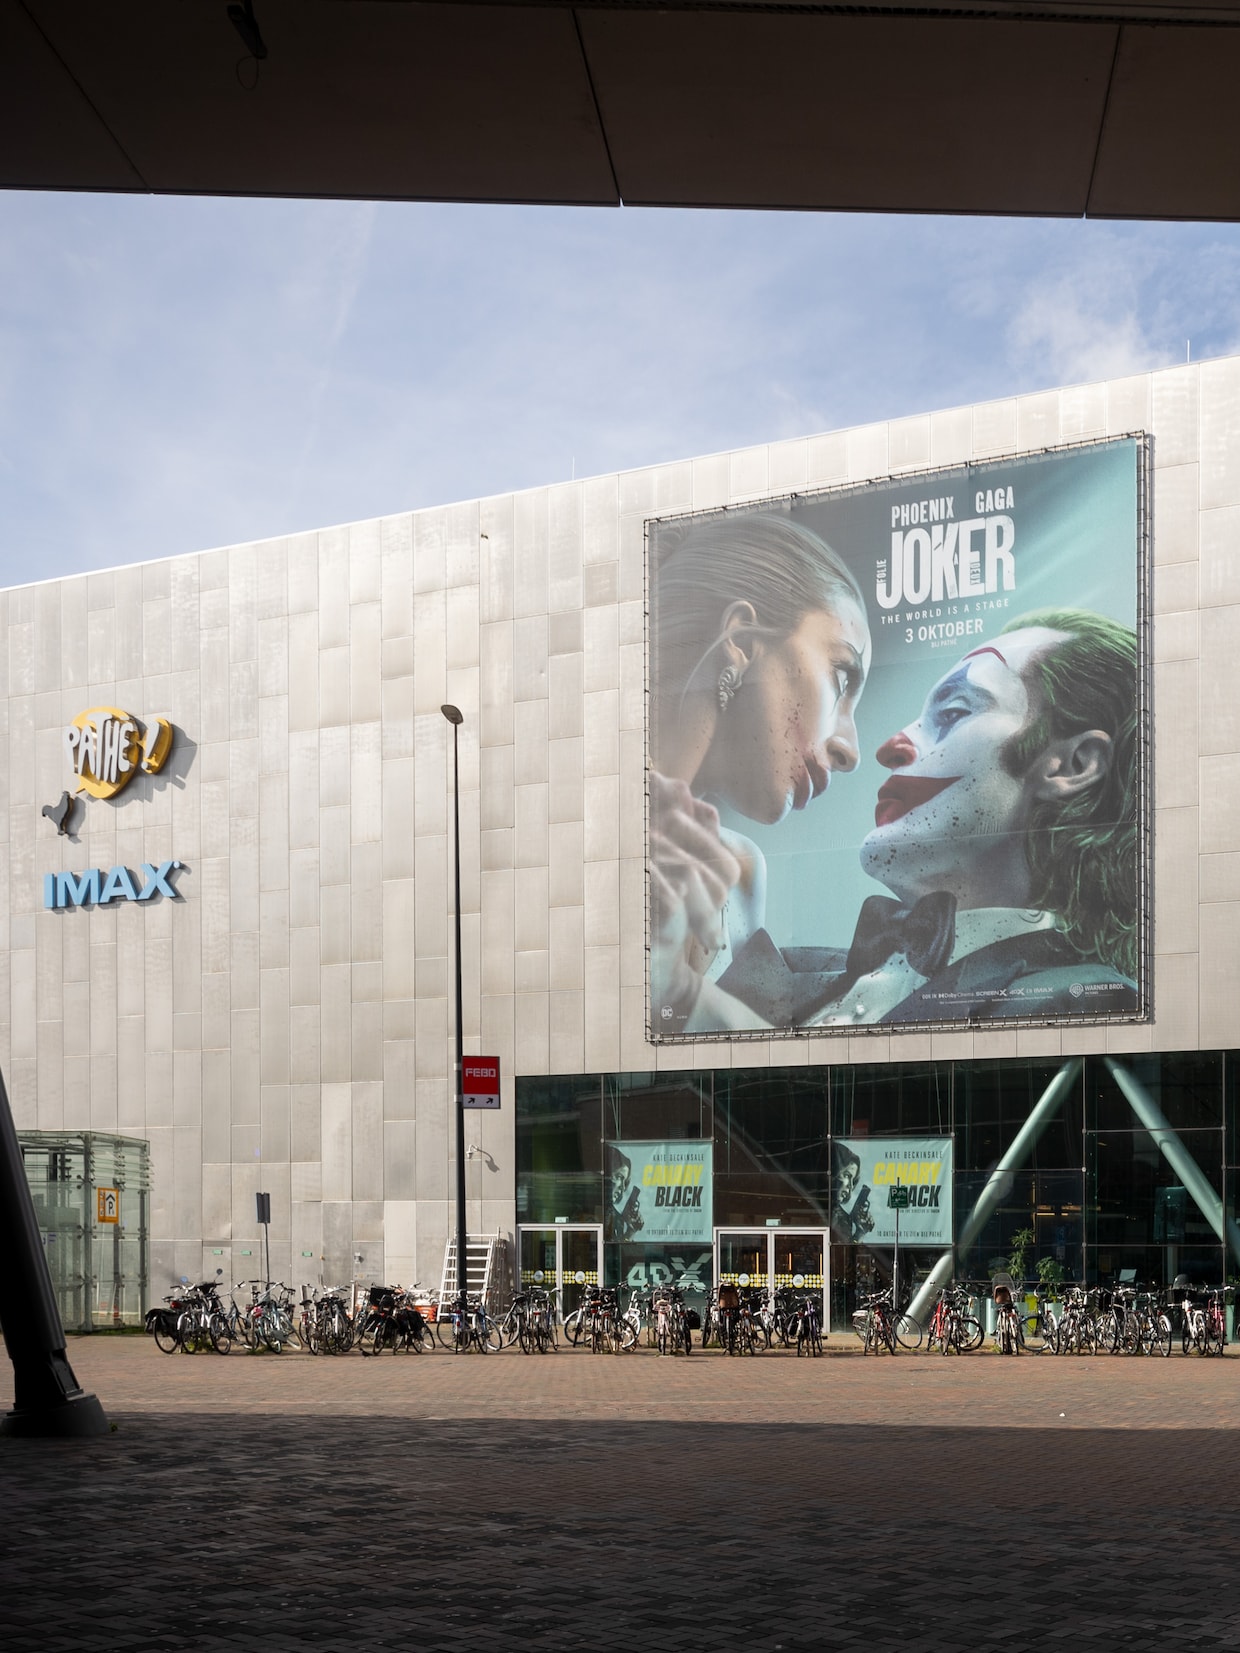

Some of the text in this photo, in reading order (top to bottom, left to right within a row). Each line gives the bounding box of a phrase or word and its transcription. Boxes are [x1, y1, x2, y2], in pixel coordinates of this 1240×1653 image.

[891, 486, 1014, 528] PHOENIX GAGA
[876, 514, 1016, 609] JOKER
[876, 559, 886, 584] FOLIE
[970, 562, 980, 584] DEUX
[881, 598, 1009, 624] THE WORLD IS A STAGE
[905, 618, 983, 643] 3 OKTOBER
[44, 861, 176, 908] IMAX
[661, 1007, 673, 1019] DC
[466, 1068, 496, 1077] FEBO
[642, 1164, 704, 1187] CANARY
[872, 1161, 942, 1184] CANARY
[655, 1186, 703, 1207] BLACK
[626, 1253, 713, 1292] 4DX
